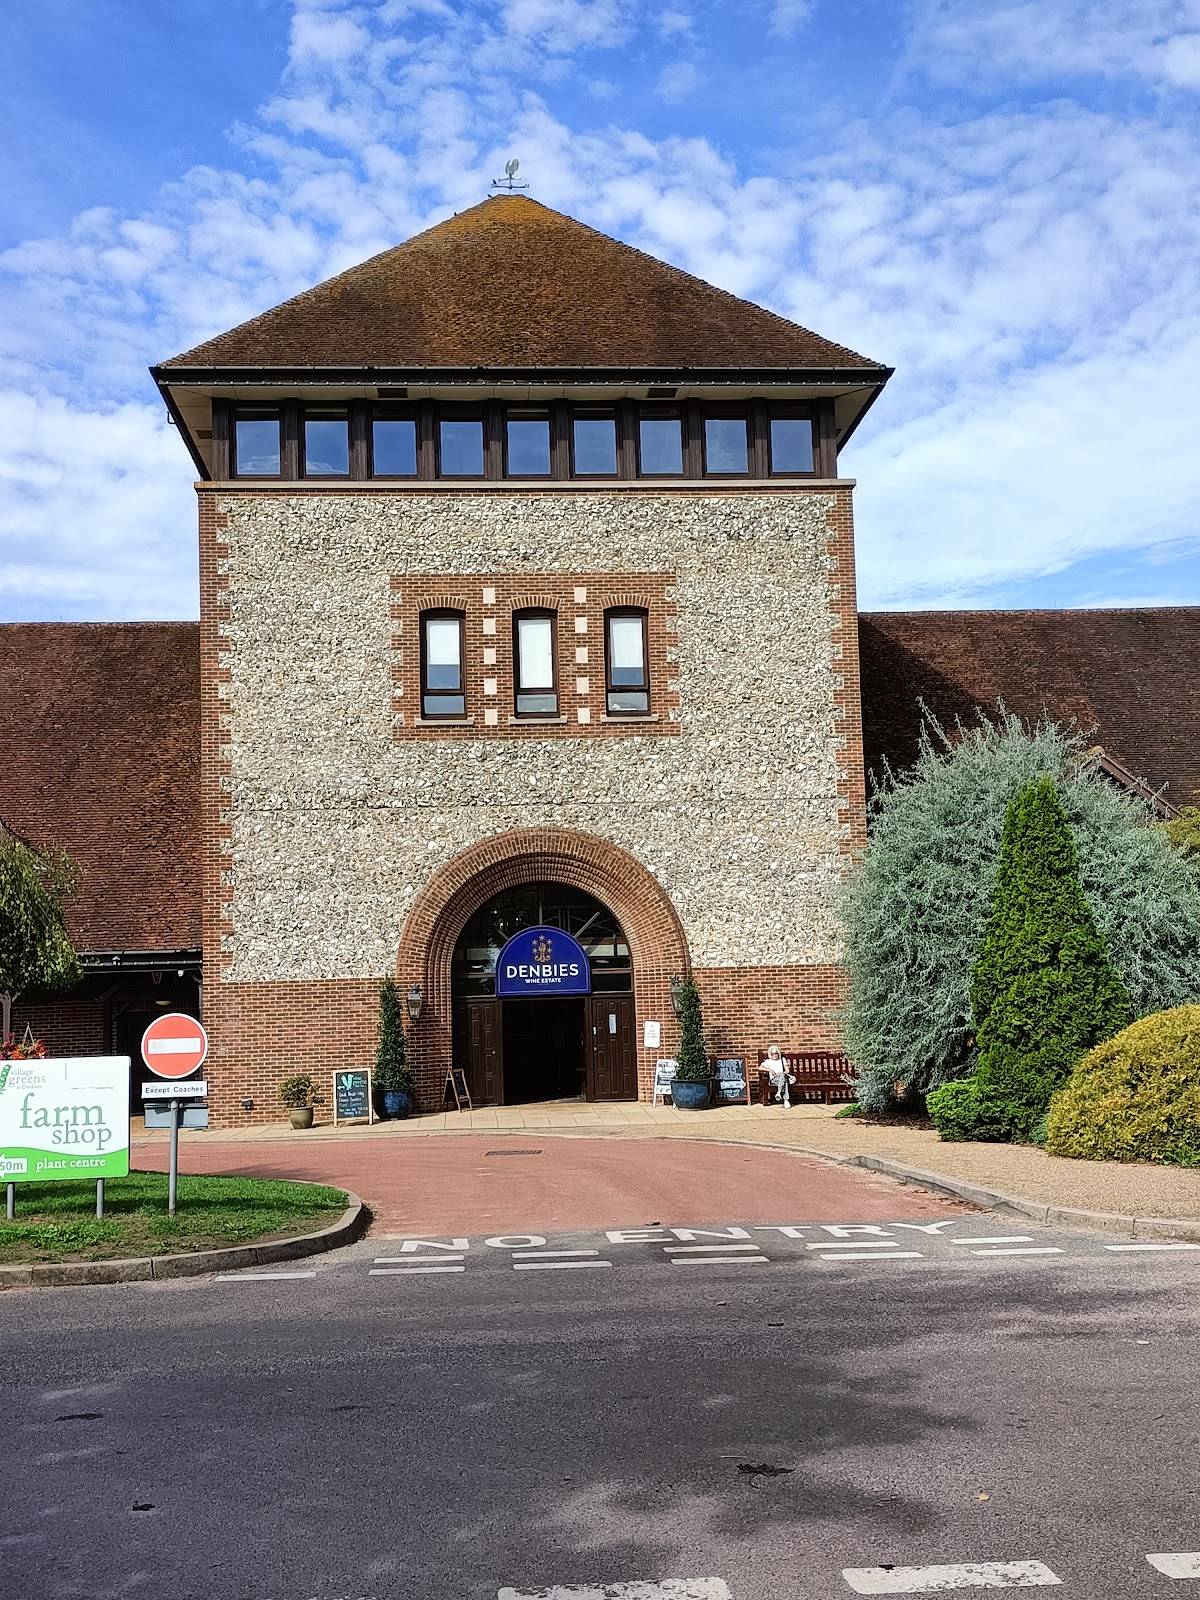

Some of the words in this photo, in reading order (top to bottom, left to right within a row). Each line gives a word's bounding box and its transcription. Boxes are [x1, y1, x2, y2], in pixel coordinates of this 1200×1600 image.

[506, 964, 579, 979] DENBIES
[11, 1068, 34, 1077] village
[9, 1075, 47, 1088] greens
[19, 1092, 107, 1129] farm
[51, 1119, 112, 1151] shop
[36, 1157, 67, 1173] plant
[69, 1158, 106, 1168] centre
[400, 1235, 547, 1252] NO
[605, 1221, 957, 1244] ENTRY
